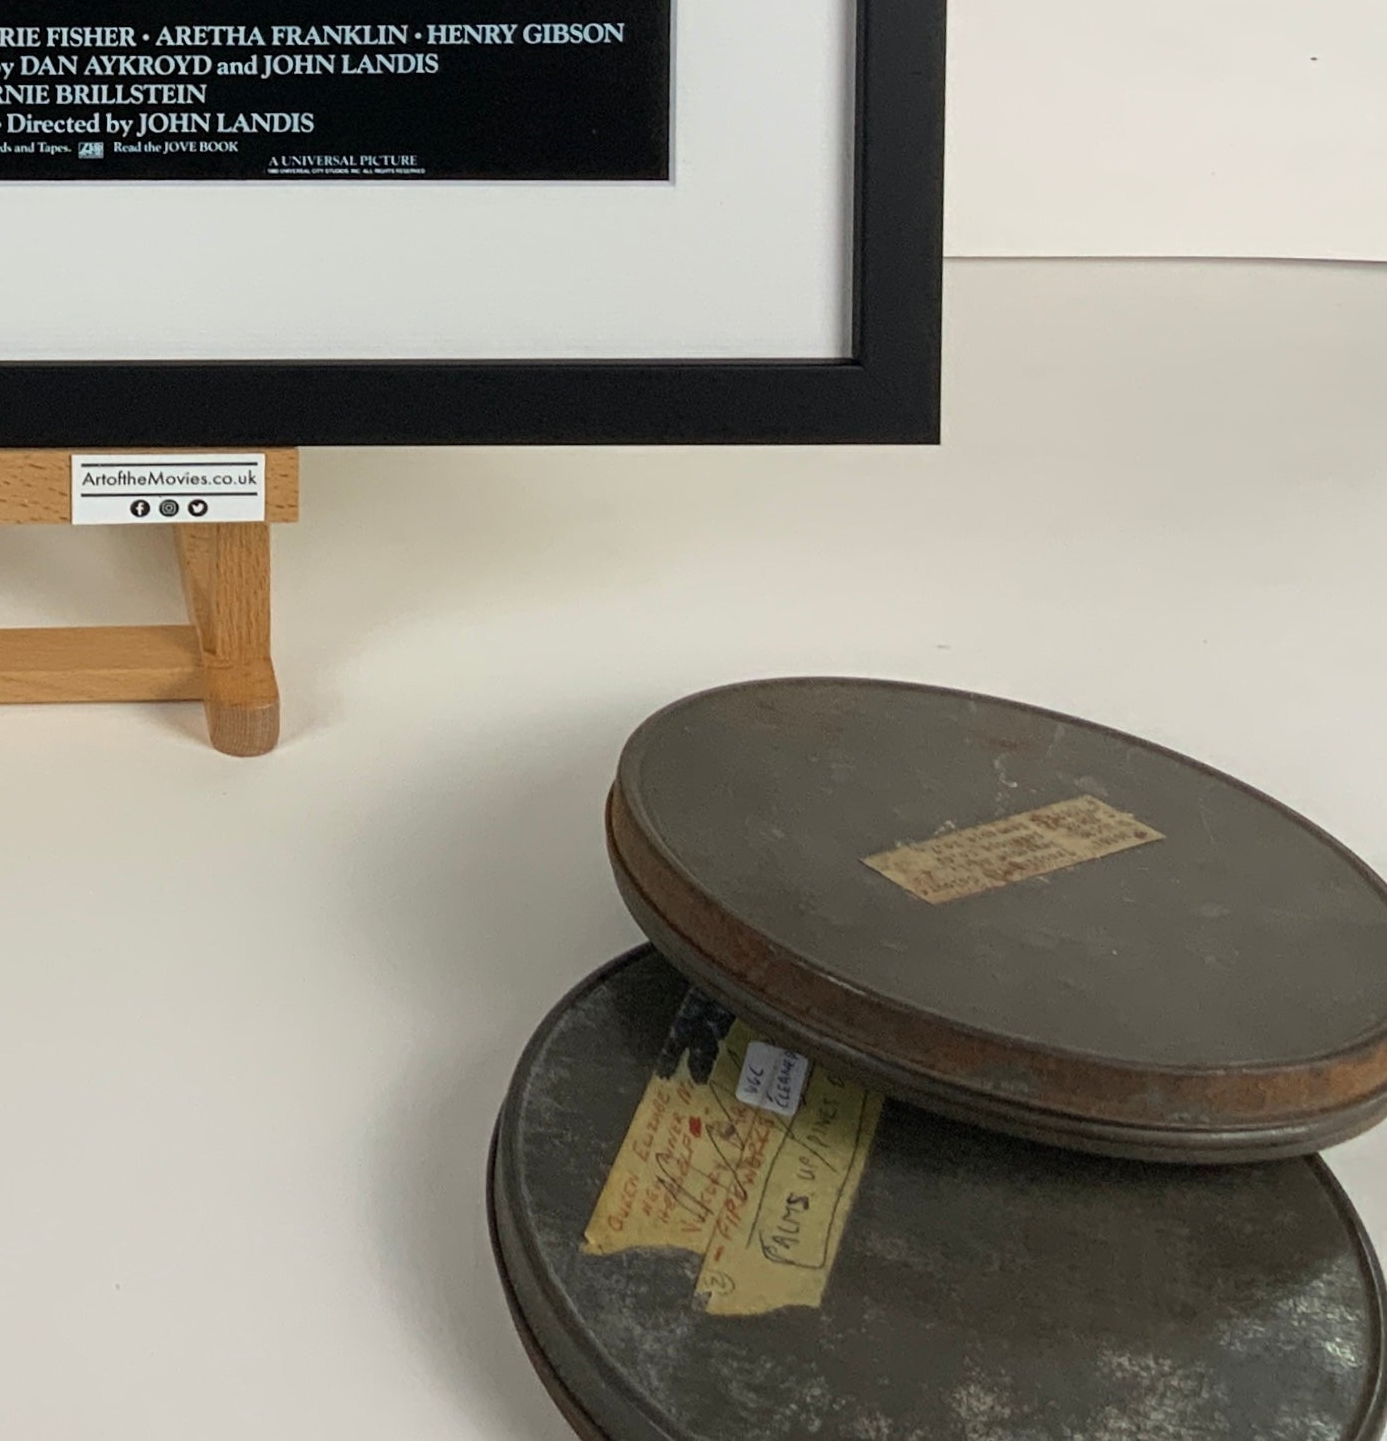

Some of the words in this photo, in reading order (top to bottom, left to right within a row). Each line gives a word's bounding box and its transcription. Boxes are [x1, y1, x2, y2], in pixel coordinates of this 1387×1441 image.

[46, 25, 137, 47] FISHER
[155, 24, 266, 46] ARETHA
[271, 24, 409, 46] FRANKLIN
[426, 22, 518, 45] HENRY
[522, 21, 625, 44] GIBSON
[20, 54, 78, 76] DAN
[83, 54, 213, 76] AYKROYD
[216, 54, 258, 75] and
[260, 54, 336, 80] JOHN
[341, 53, 439, 74] LANDIS
[55, 83, 207, 105] BRILLSTEIN
[6, 112, 101, 134] Directed
[105, 112, 134, 138] by
[136, 112, 211, 138] JOHN
[216, 111, 315, 133] LANDIS
[13, 141, 35, 153] and
[37, 141, 72, 156] Tapes.
[113, 141, 142, 153] Read
[143, 141, 162, 153] the
[162, 140, 197, 155] JOVE
[199, 140, 239, 153] BOOK
[268, 155, 279, 167] A
[281, 154, 357, 167] UNIVERSAL
[359, 154, 418, 167] PICTURE
[81, 469, 258, 487] ArtoftheMovies.co.uk
